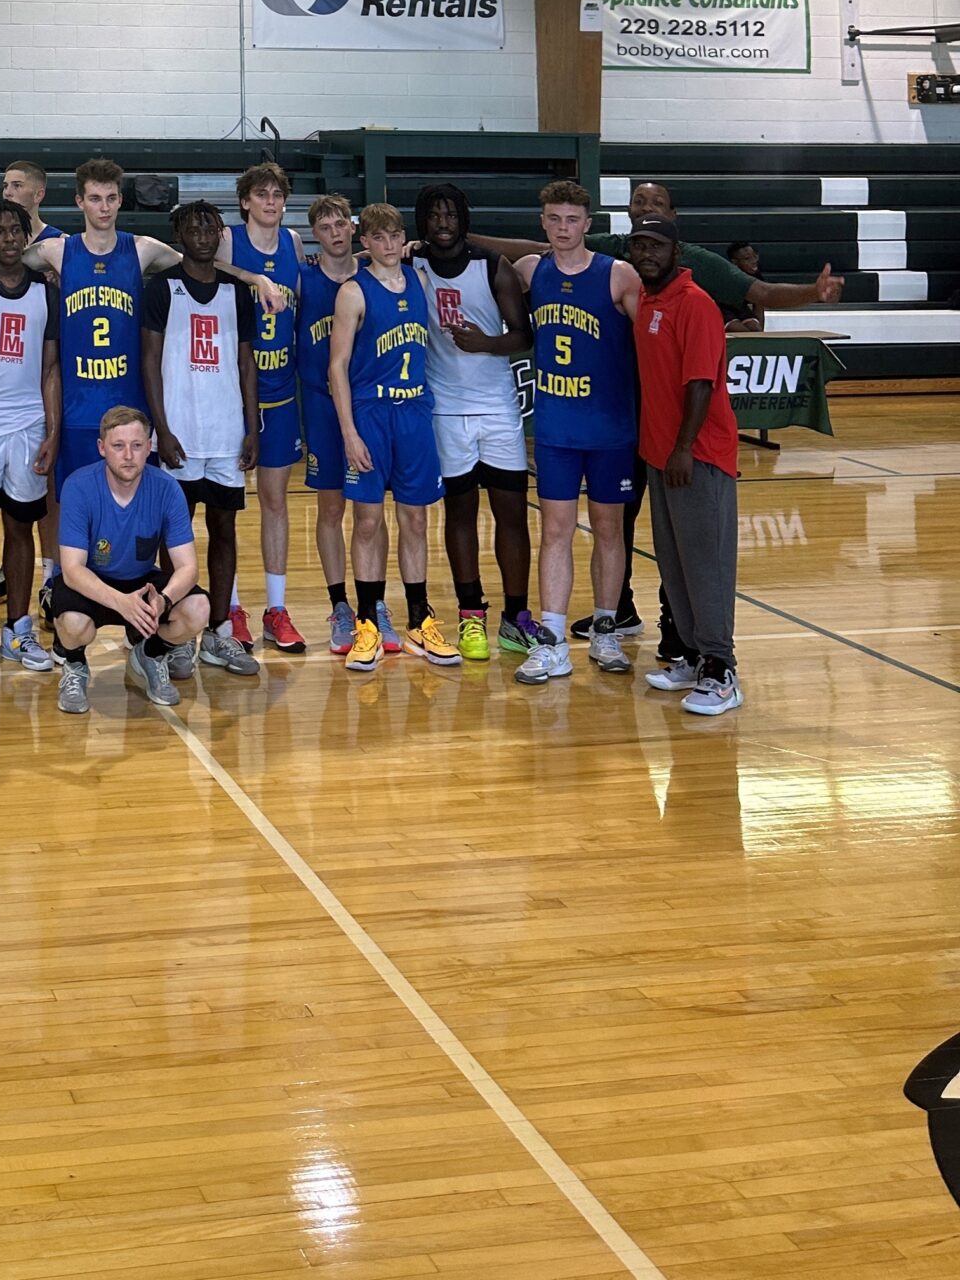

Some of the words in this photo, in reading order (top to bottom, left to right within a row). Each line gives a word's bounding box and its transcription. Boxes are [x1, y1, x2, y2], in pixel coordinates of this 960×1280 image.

[620, 18, 765, 37] 229.228.5112
[617, 43, 769, 61] bobbydollar.com
[65, 286, 97, 317] YOUTH
[98, 286, 134, 317] SPORTS
[92, 317, 110, 346] 2
[260, 313, 276, 340] 3
[310, 315, 335, 345] YOUT
[562, 304, 600, 340] SPORTS
[253, 346, 289, 370] ONS
[555, 335, 572, 365] 5
[76, 354, 127, 380] LIONS
[189, 364, 220, 373] SPORTS
[400, 352, 411, 380] 1
[726, 355, 804, 395] SUN
[537, 368, 591, 398] LIONS
[731, 395, 810, 411] ONFERENCE
